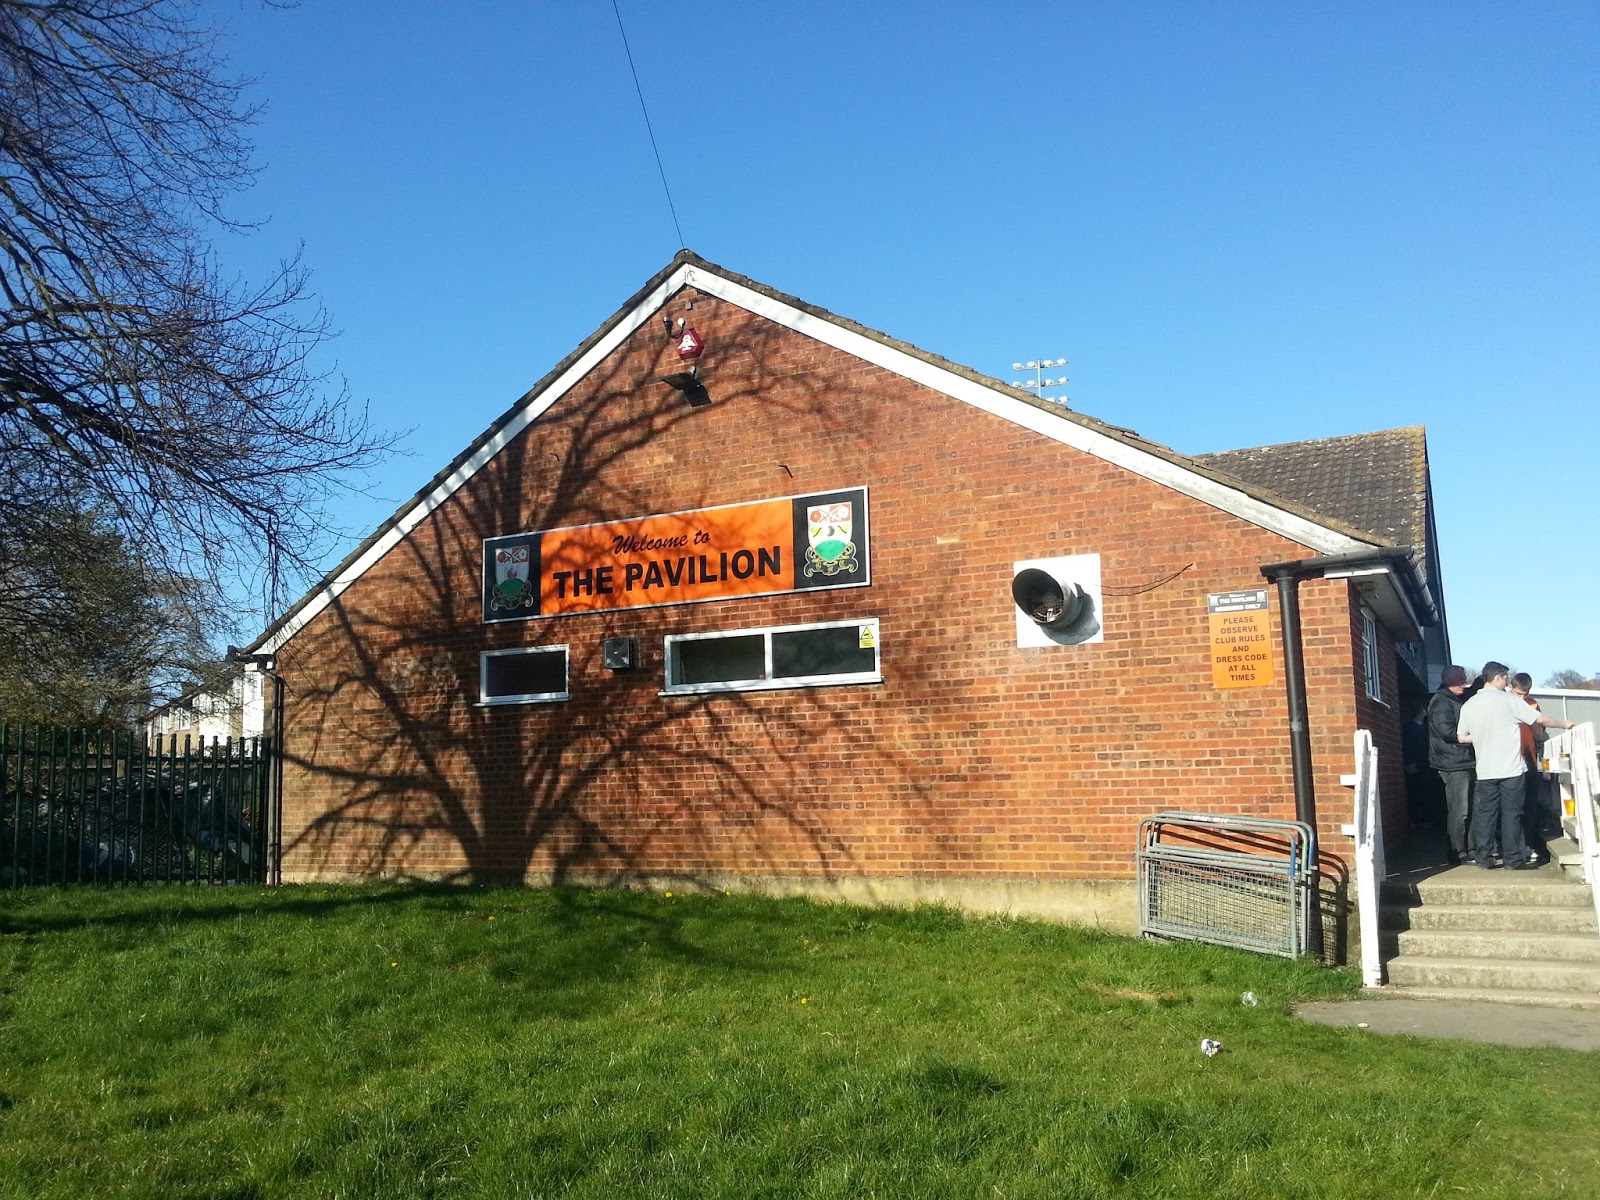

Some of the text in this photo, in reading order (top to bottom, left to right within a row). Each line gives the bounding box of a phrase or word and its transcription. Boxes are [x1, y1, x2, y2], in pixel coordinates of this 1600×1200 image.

[612, 529, 711, 555] Welcome to
[553, 545, 781, 598] THE PAVILION
[1223, 616, 1254, 624] PLEASE
[1220, 625, 1258, 634] OBSERVE
[1215, 634, 1265, 644] CLUB RULES
[1216, 653, 1267, 663] DRESS CODE
[1230, 673, 1255, 681] TIMES
